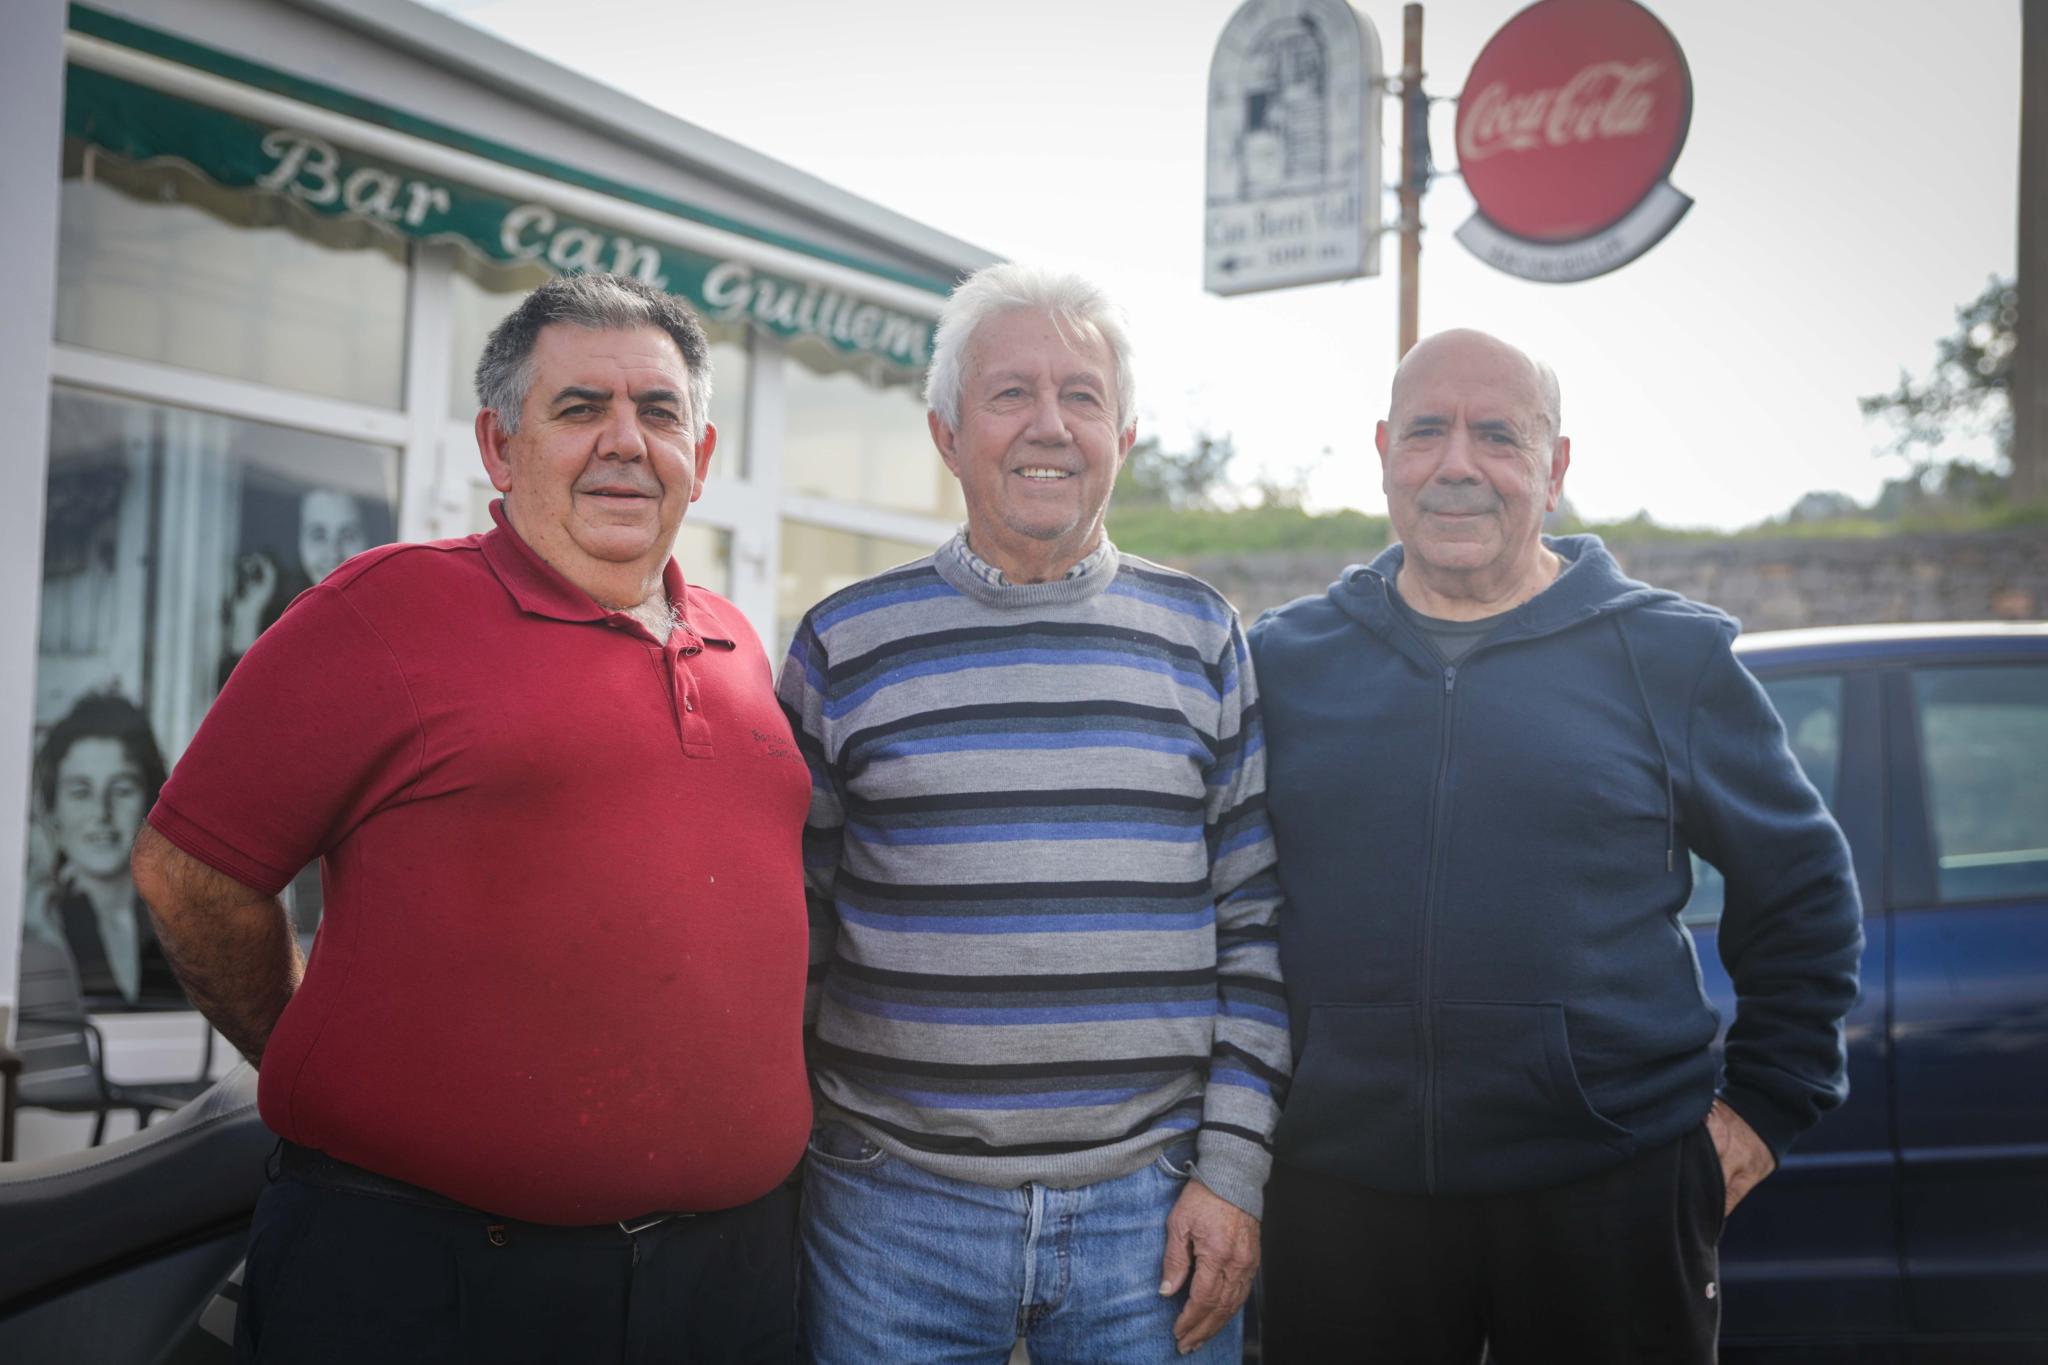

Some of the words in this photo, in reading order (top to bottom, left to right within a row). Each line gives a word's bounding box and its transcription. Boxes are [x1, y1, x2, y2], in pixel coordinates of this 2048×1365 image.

[254, 128, 450, 227] Bar
[500, 203, 670, 291] Can
[701, 258, 932, 366] Guillem
